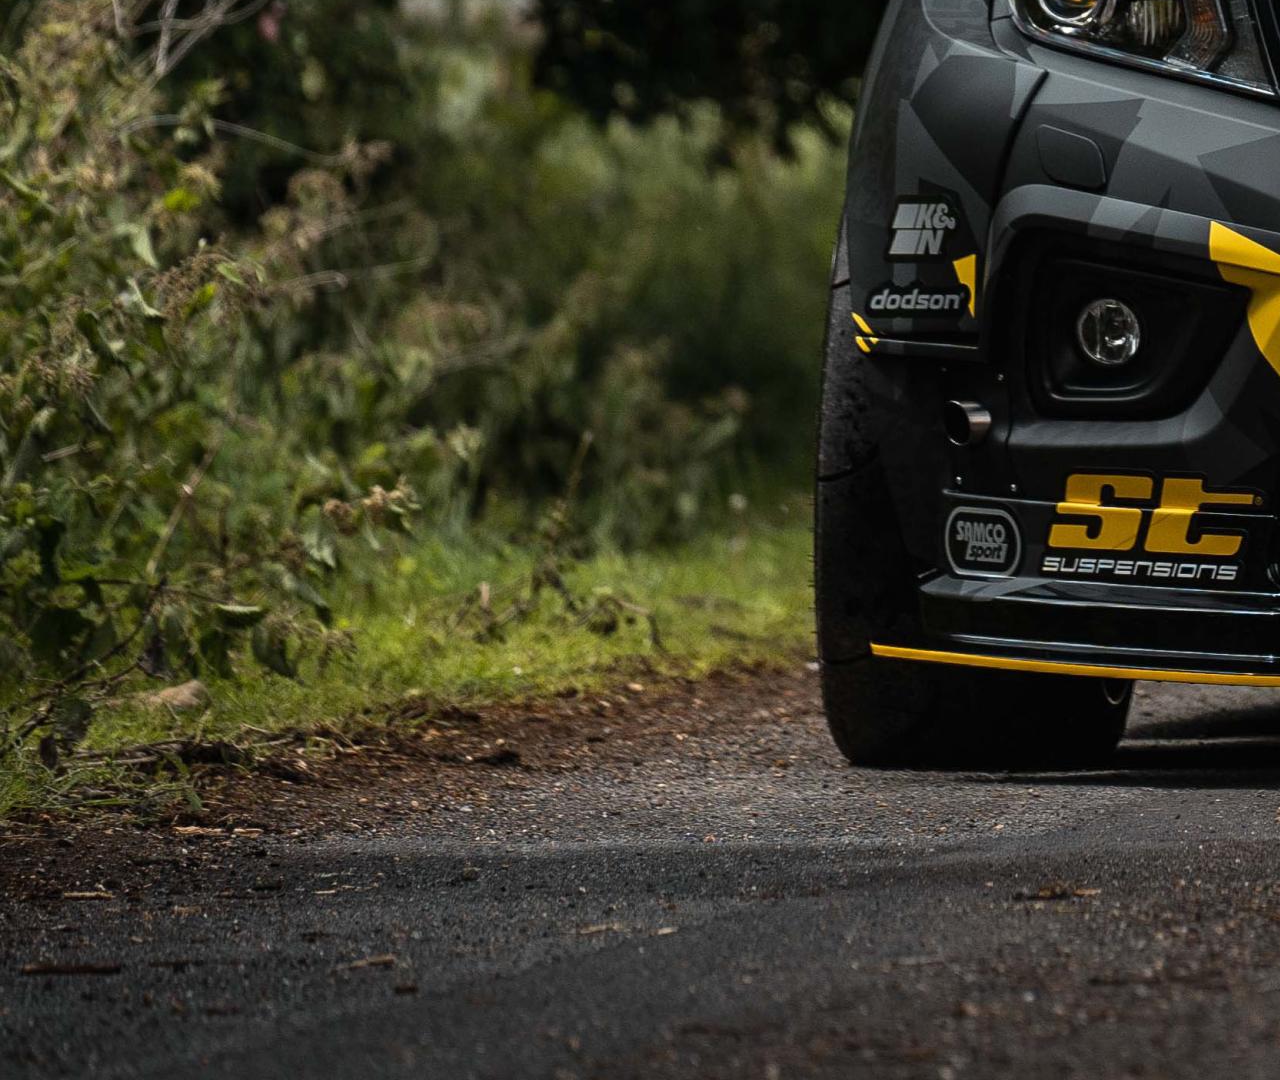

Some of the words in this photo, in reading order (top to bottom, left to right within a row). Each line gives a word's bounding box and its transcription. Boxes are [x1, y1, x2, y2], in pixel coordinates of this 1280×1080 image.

[870, 288, 960, 310] dodson
[956, 520, 1006, 543] SAMCO
[969, 544, 1003, 560] sport
[1041, 556, 1238, 581] SUSPENSIONS
